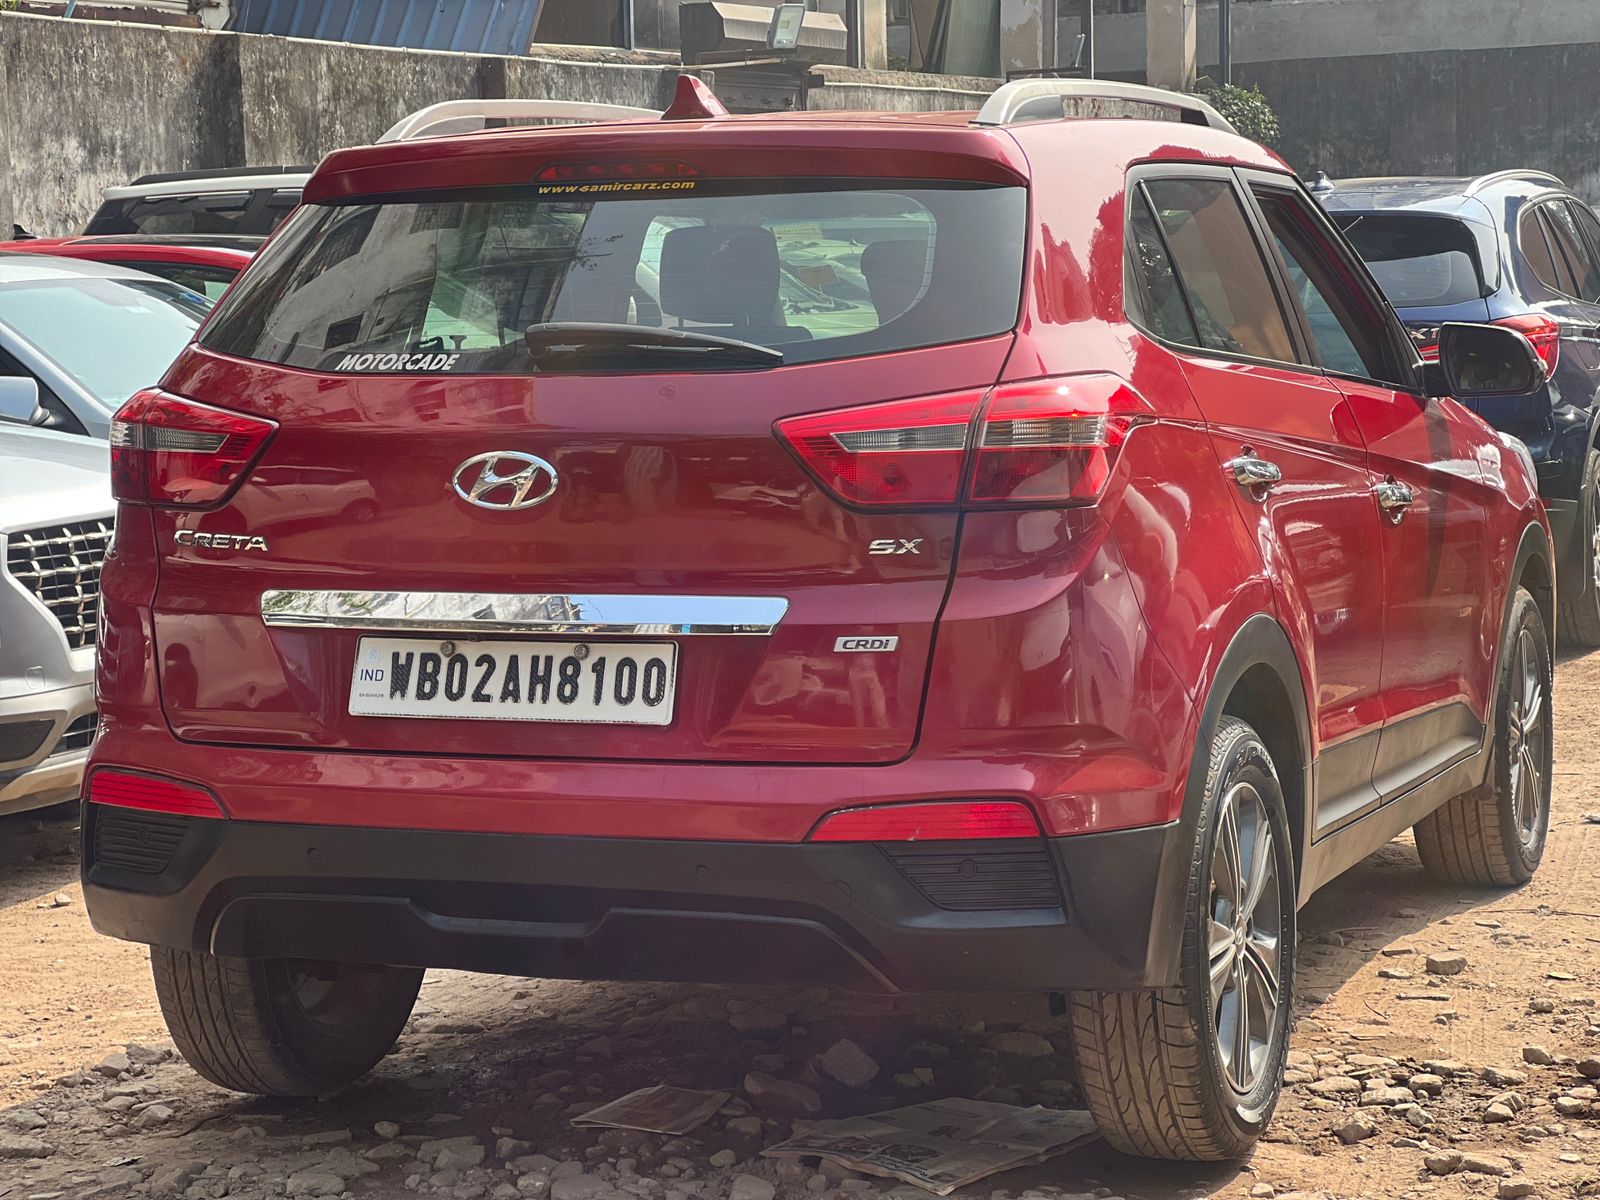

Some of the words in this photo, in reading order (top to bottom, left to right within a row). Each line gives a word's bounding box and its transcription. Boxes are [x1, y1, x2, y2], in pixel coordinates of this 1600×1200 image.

[335, 353, 459, 371] MOTORCADE
[173, 529, 268, 552] CRETA
[868, 538, 924, 555] SX
[360, 668, 384, 682] IND
[389, 650, 667, 707] WB02AH8100
